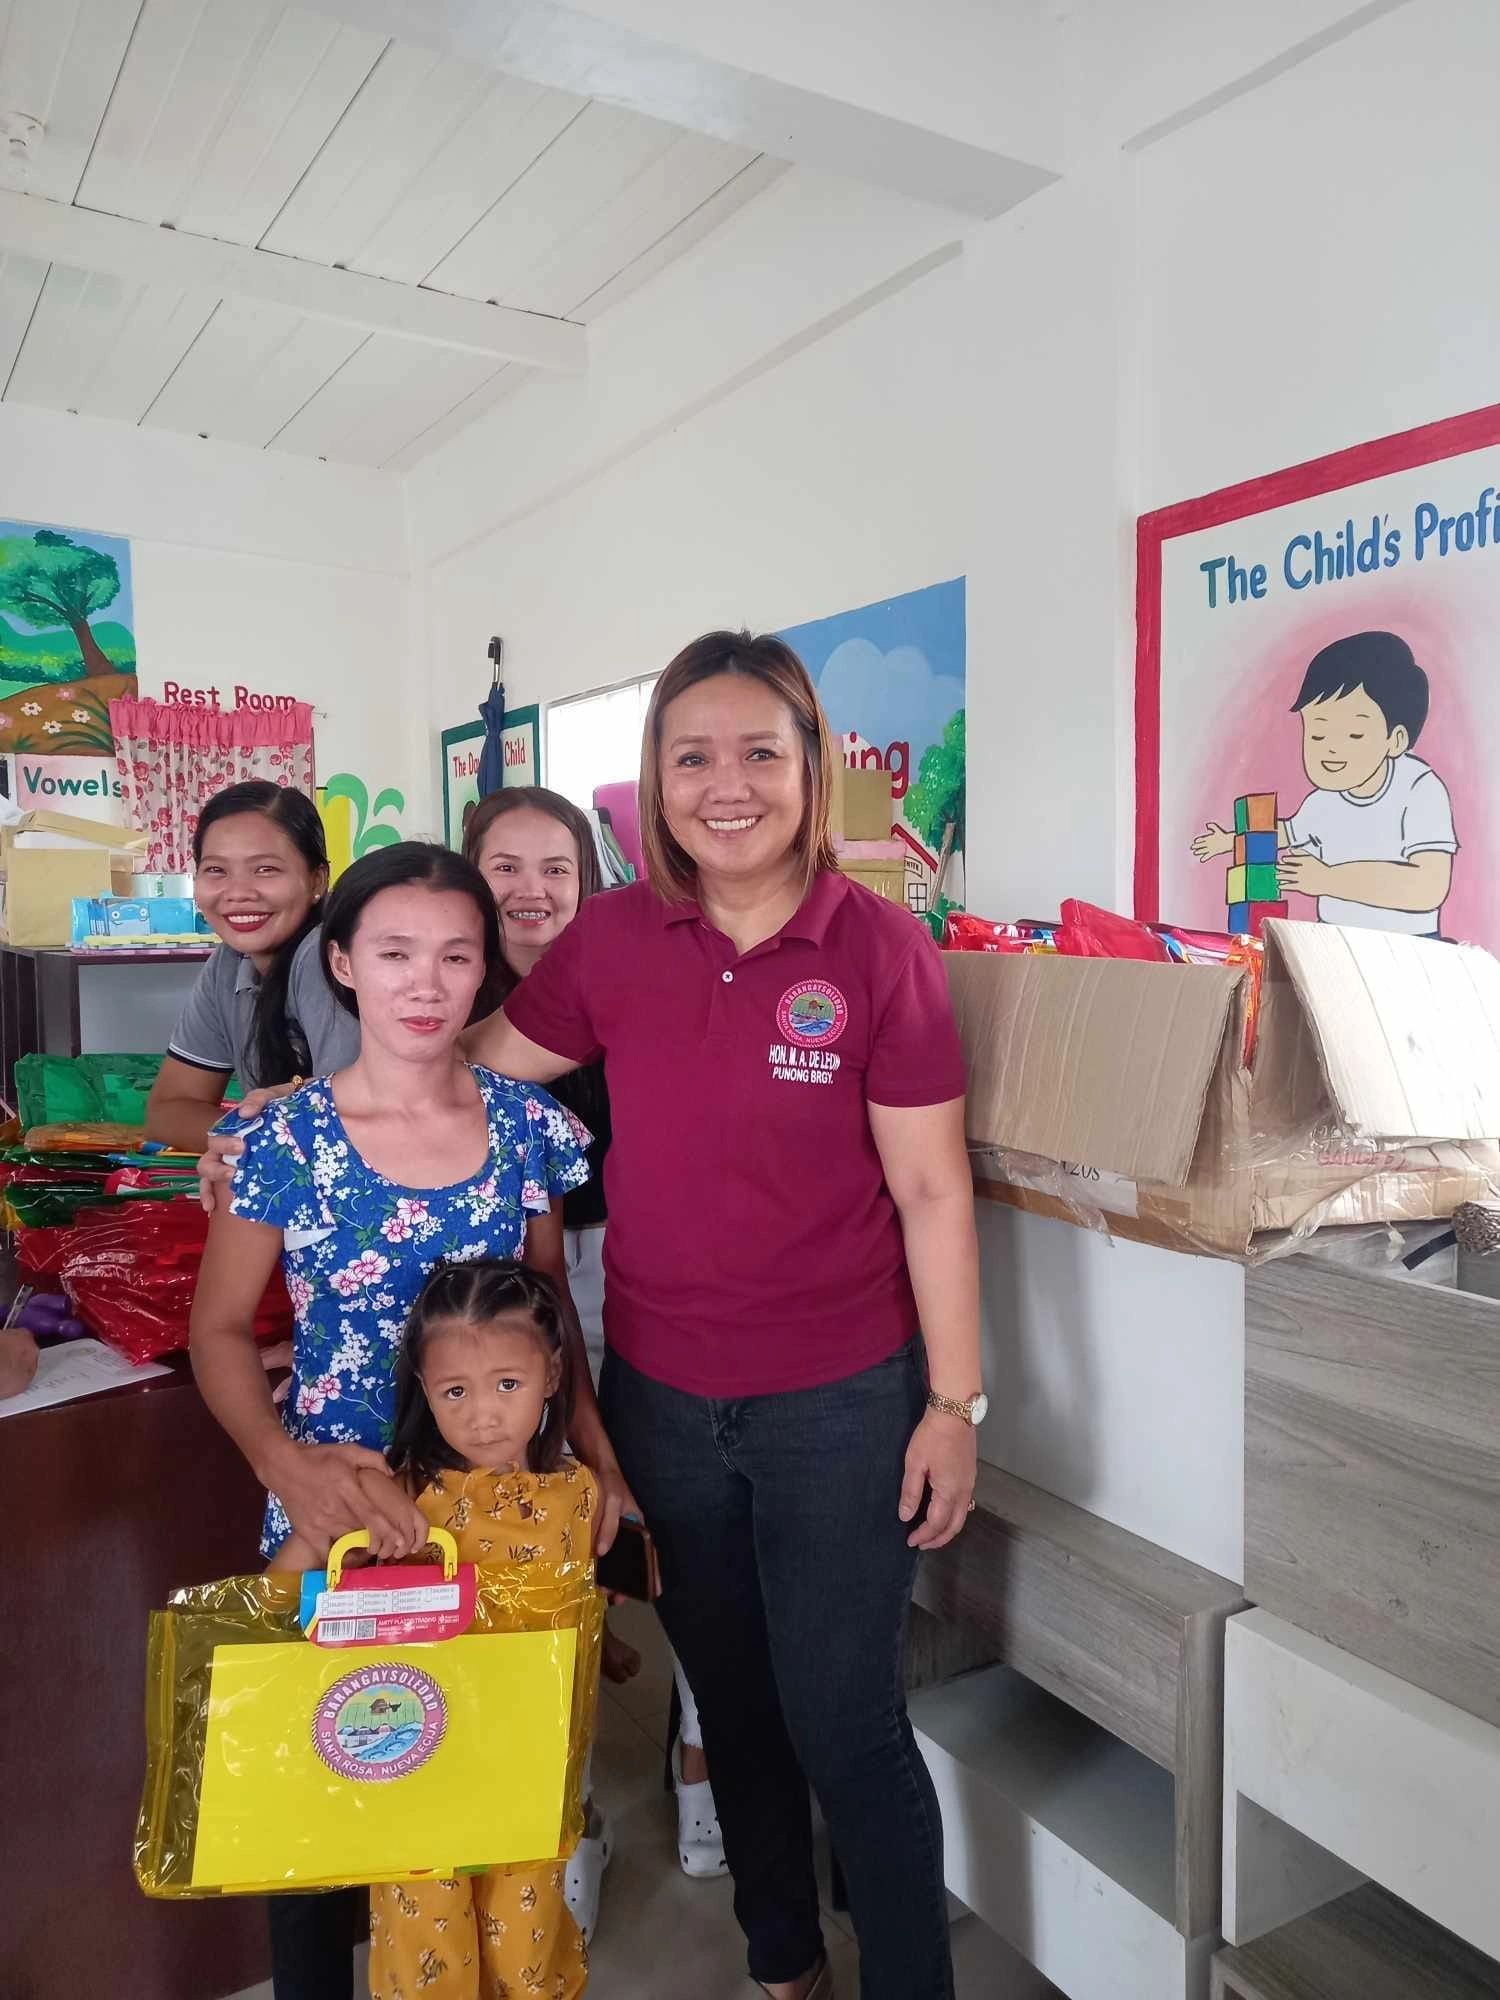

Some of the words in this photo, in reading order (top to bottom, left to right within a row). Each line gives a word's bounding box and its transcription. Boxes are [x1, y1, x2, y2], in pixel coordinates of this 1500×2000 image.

[1200, 555, 1267, 609] The
[1284, 514, 1401, 590] Child's
[164, 681, 220, 706] Rest
[235, 686, 297, 711] Room
[453, 756, 466, 778] The
[504, 738, 526, 767] Child
[844, 731, 909, 799] ing
[23, 766, 122, 797] Vowels
[773, 1066, 809, 1083] PUNONG
[811, 1069, 833, 1084] BRGY.
[321, 1730, 341, 1761] SANTA
[381, 1752, 419, 1776] NUEVA
[416, 1721, 439, 1753] ECIJA
